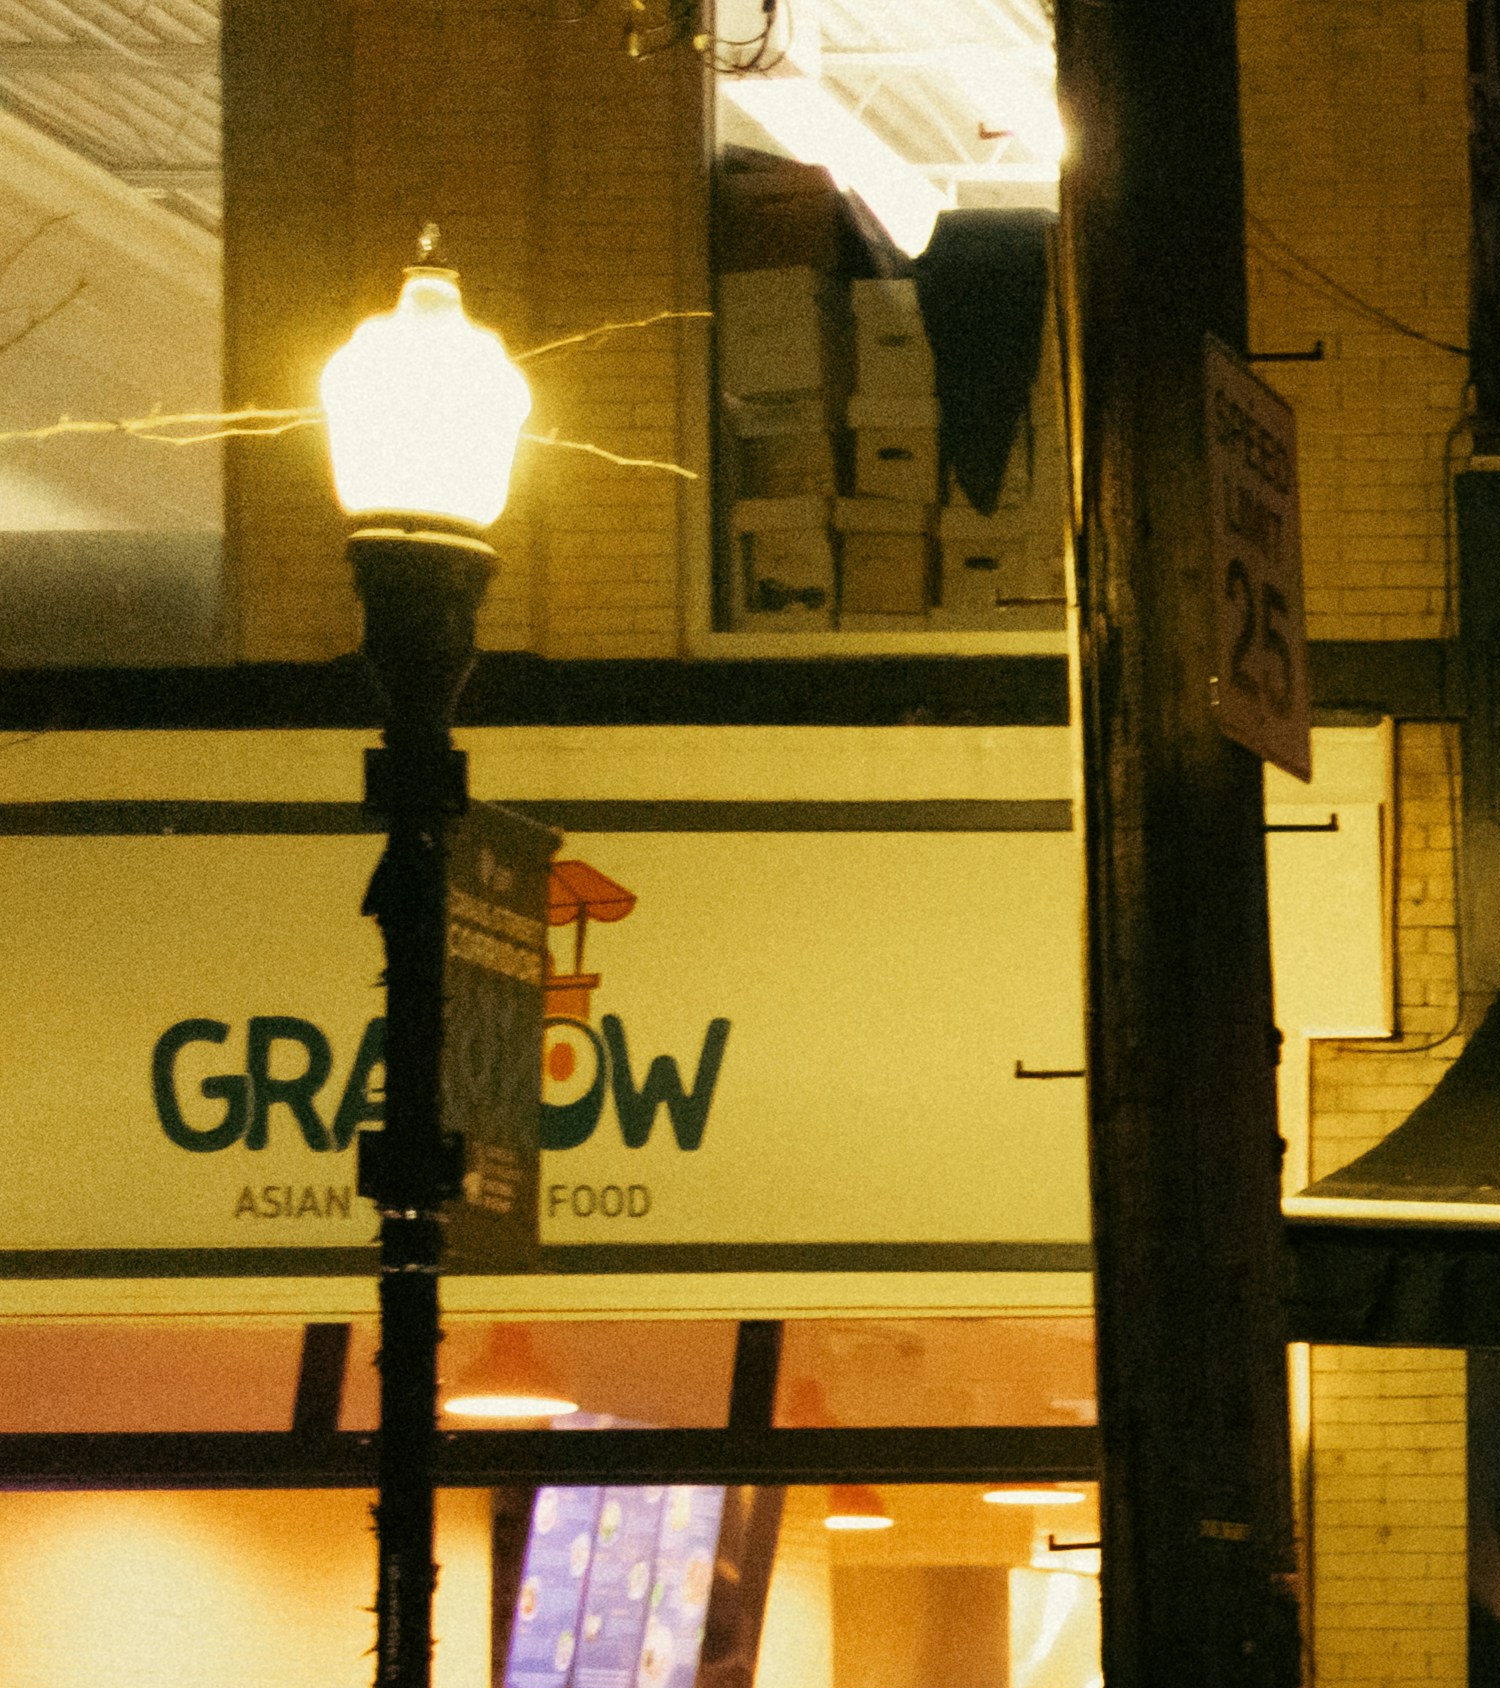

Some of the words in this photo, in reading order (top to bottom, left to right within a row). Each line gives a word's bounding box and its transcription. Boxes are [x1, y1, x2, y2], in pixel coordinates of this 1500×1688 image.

[1226, 557, 1292, 720] 25
[233, 1184, 352, 1220] ASIAN
[546, 1183, 653, 1219] FOOD
